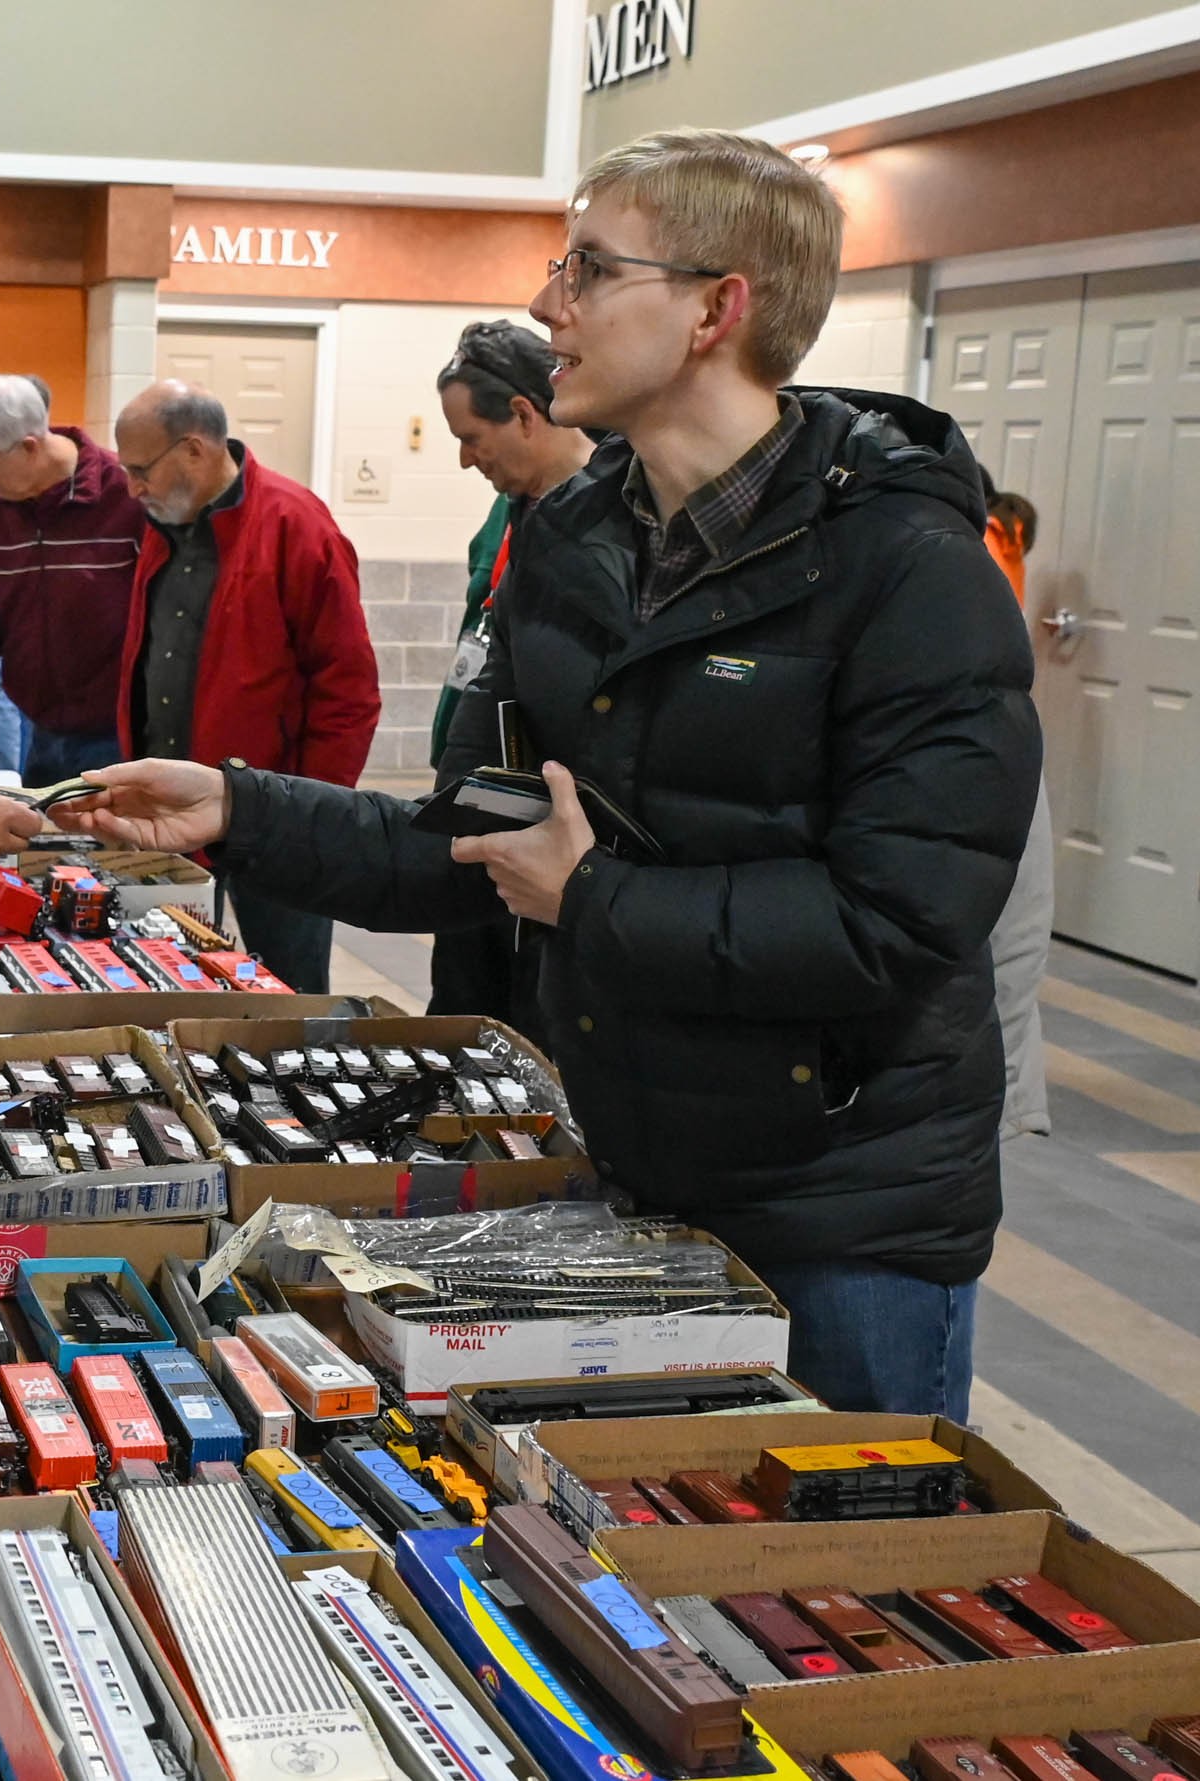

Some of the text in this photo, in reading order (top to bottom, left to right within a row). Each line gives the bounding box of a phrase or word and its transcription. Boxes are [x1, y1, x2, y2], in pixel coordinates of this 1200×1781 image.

[584, 0, 690, 93] MEN
[171, 224, 338, 268] AMILY
[705, 665, 744, 681] L.L.Bean
[429, 1324, 509, 1338] PRIORITY
[446, 1338, 486, 1350] MAIL
[664, 1364, 689, 1372] VISIT
[690, 1363, 704, 1371] US
[225, 1723, 362, 1743] WALTHERS
